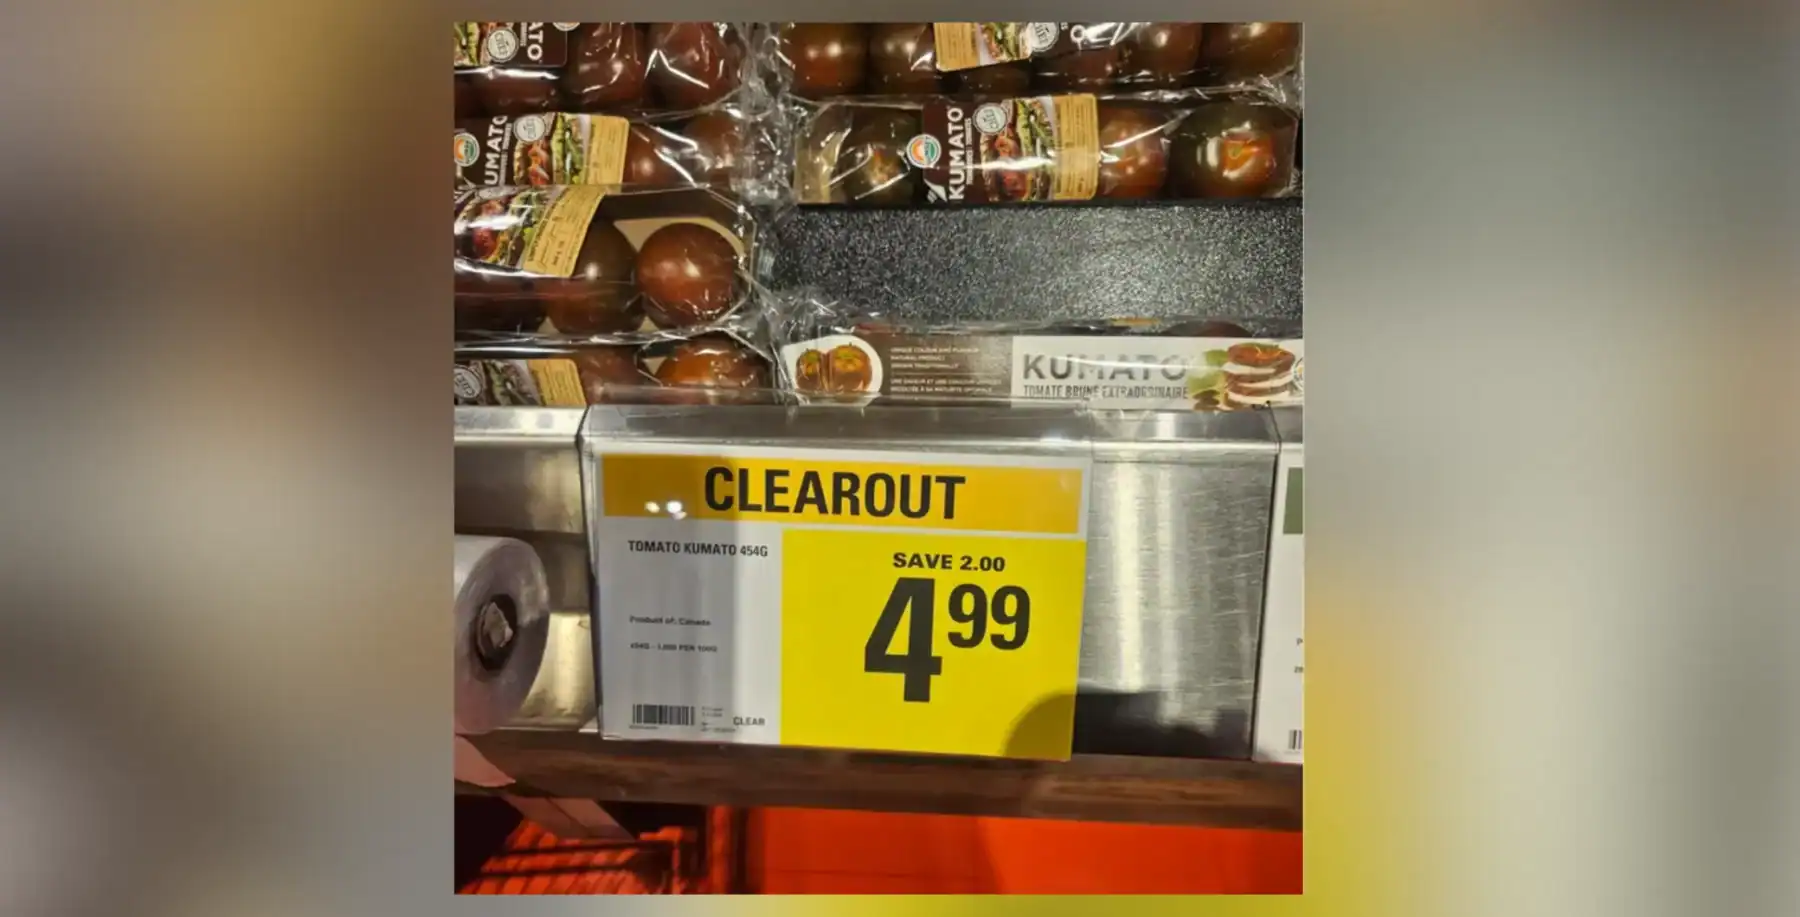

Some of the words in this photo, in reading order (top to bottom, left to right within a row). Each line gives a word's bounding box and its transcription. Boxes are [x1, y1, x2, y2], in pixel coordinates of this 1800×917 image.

[947, 107, 965, 200] KUMATO
[1023, 354, 1187, 380] KUMATO
[1024, 384, 1063, 399] TOMATE
[704, 466, 966, 519] CLEAROUT
[628, 540, 680, 553] TOMATO
[684, 543, 737, 556] KUMATO
[740, 545, 768, 557] 454G
[893, 552, 953, 569] SAVE
[960, 555, 1005, 572] 2.00
[864, 577, 943, 703] 4
[947, 583, 1031, 651] 99
[733, 716, 765, 726] CLEAR
